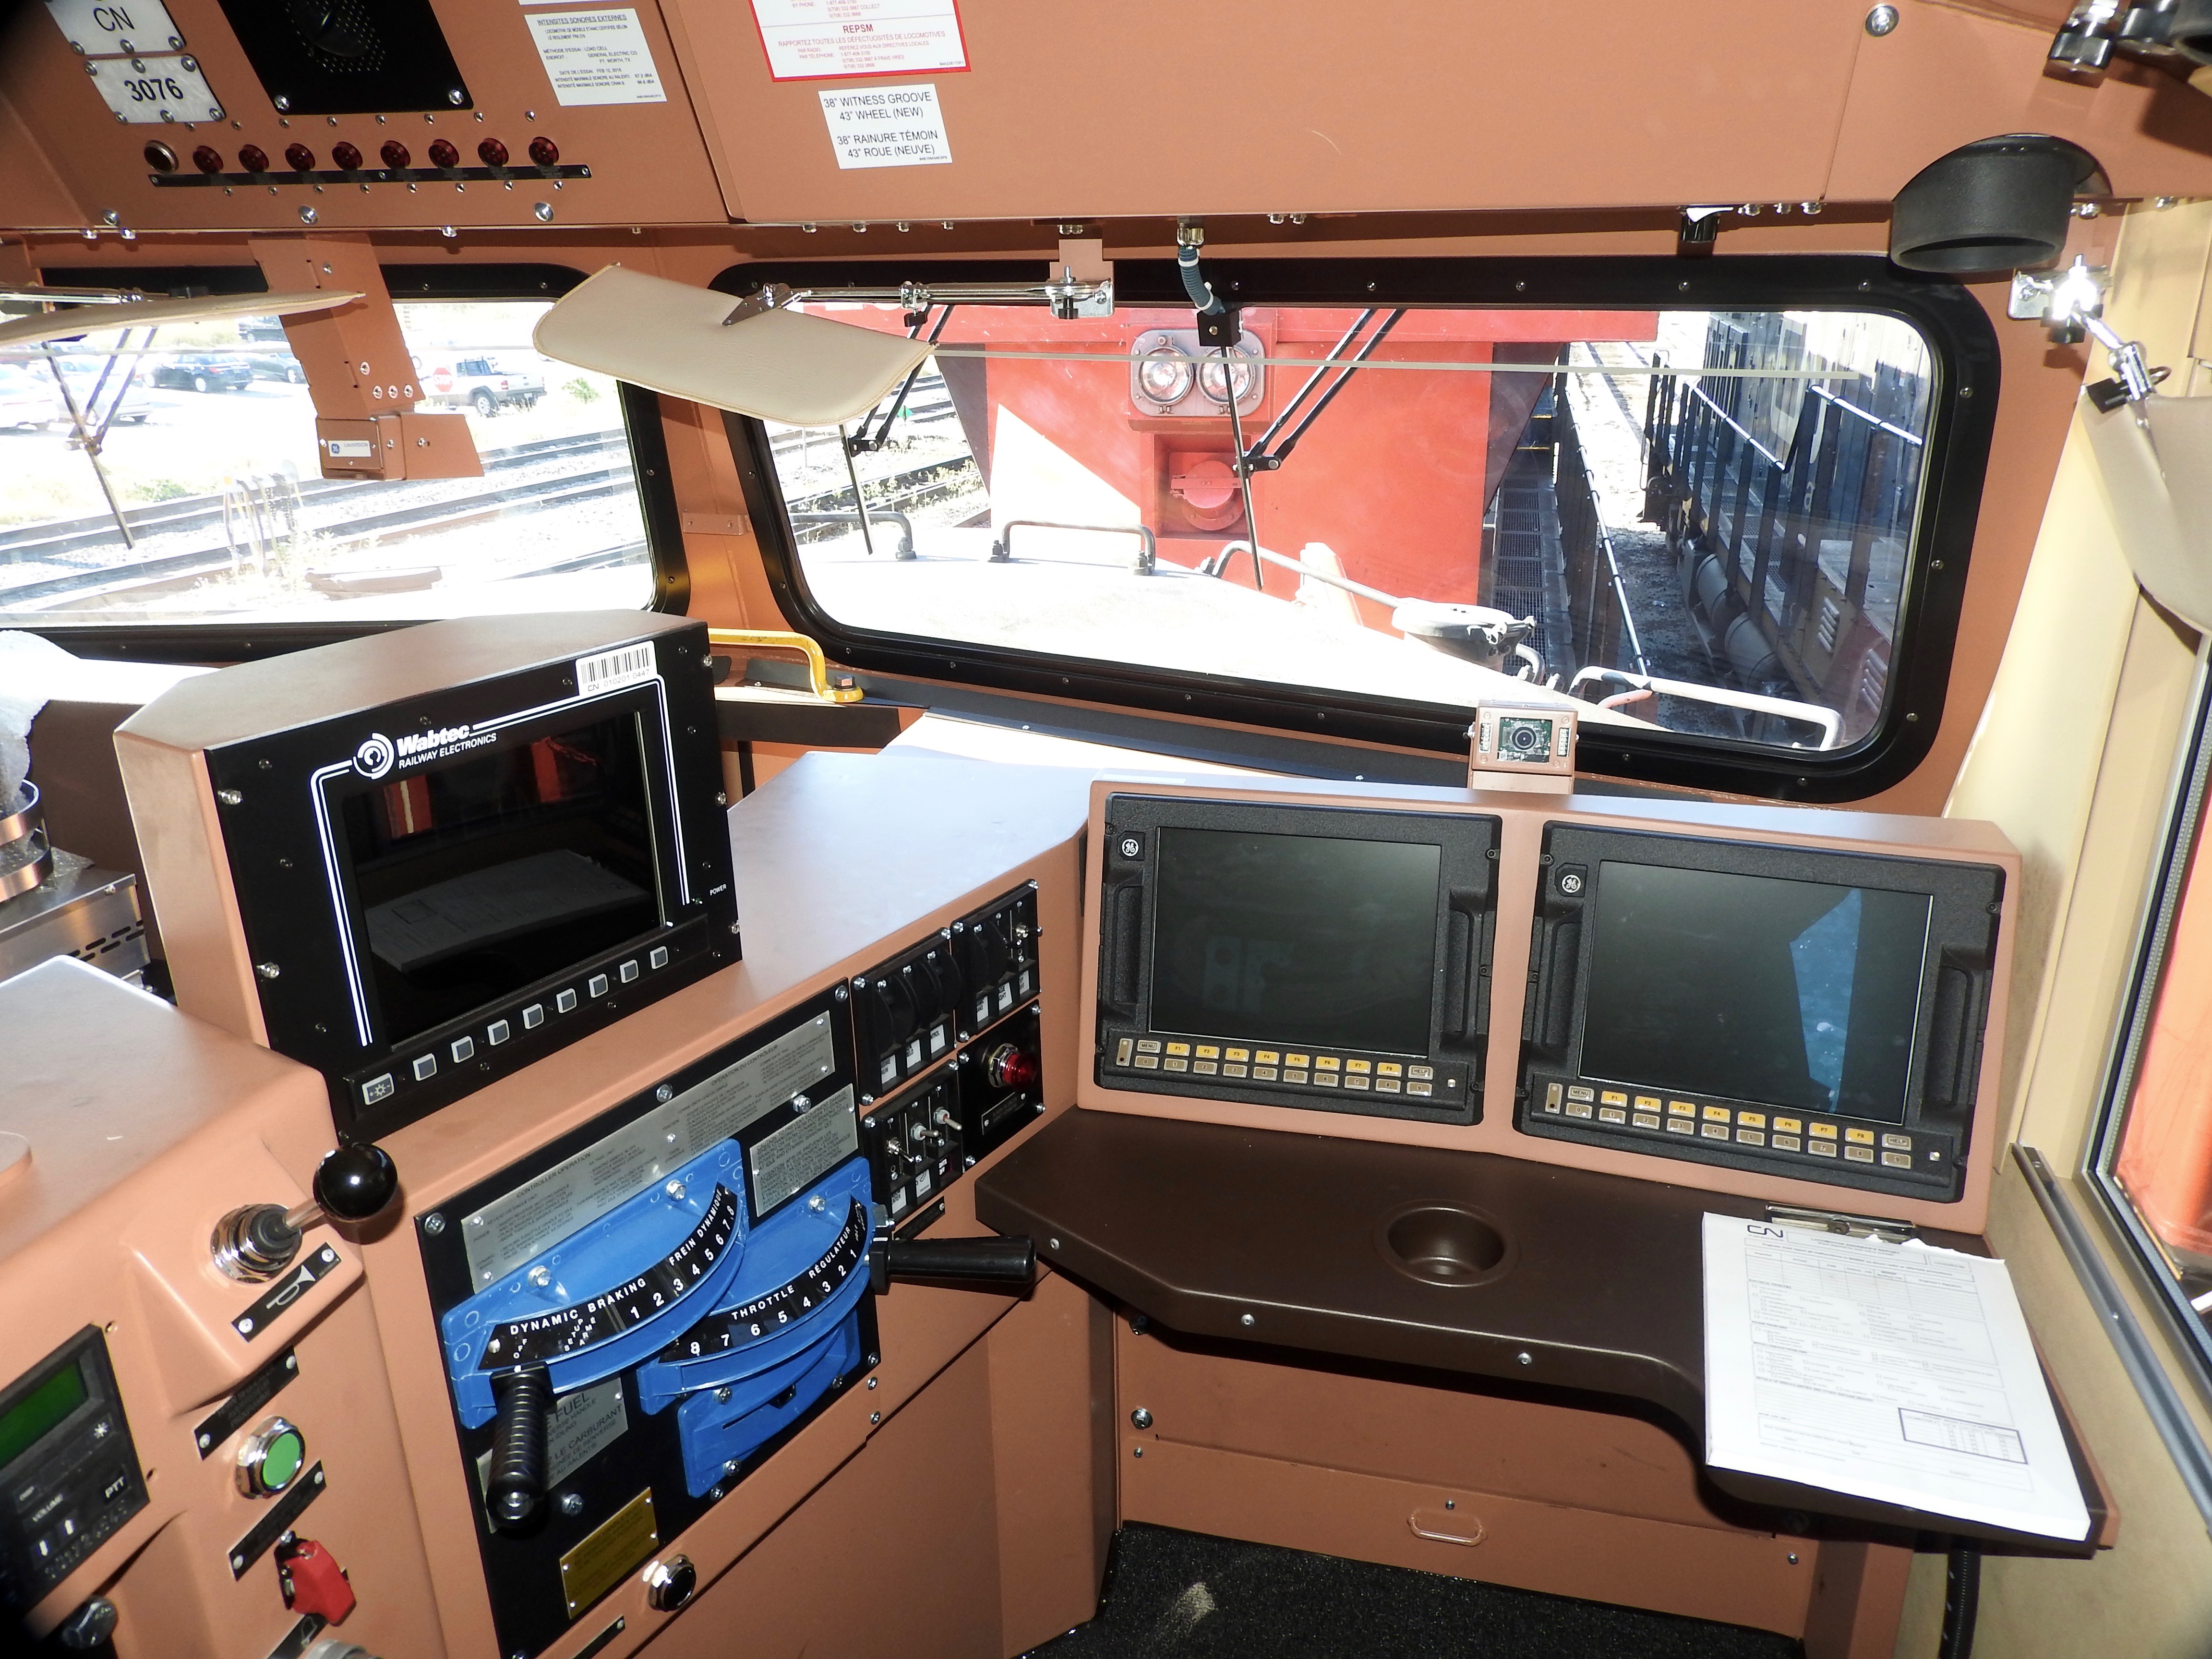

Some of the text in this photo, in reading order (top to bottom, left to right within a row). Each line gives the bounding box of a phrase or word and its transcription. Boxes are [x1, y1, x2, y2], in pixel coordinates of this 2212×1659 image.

[93, 7, 134, 31] CN
[597, 14, 627, 22] EXTERNES
[842, 24, 874, 33] REPSM
[904, 31, 945, 39] LOCOMOTIVES
[124, 78, 183, 101] 3076
[840, 95, 886, 107] WITNESS
[888, 91, 932, 104] GROOVE
[855, 109, 891, 120] WHEEL
[893, 107, 923, 120] (NEW)
[854, 132, 898, 144] RAINURE
[899, 130, 938, 141] TÉMOIN
[864, 146, 892, 157] ROUE
[894, 144, 935, 157] (NEUVE)
[433, 374, 453, 385] STOP
[588, 669, 649, 691] CN 010201 0447
[397, 724, 469, 757] Wabtec
[398, 733, 497, 769] RAILWAY ELECTRONICS
[710, 884, 726, 896] POWER
[517, 1171, 556, 1198] CONTROLLER
[557, 1152, 591, 1175] OPERATION
[669, 1189, 722, 1266] FREIN DYNAMIQUE
[1747, 1225, 1783, 1238] CN
[630, 1205, 734, 1319] 1 2 3 4 5 6 7 8
[731, 1226, 851, 1320] THROTTLE RÉGULATEUR
[510, 1278, 647, 1335] DYNAMIC BRAKING
[690, 1249, 857, 1354] 8 7 6 5 4 3 2 1
[579, 1316, 596, 1346] ARMÉ
[513, 1338, 527, 1359] OFF
[555, 1393, 589, 1422] FUEL
[568, 1404, 622, 1449] CARBURANT
[105, 1476, 124, 1499] PTT
